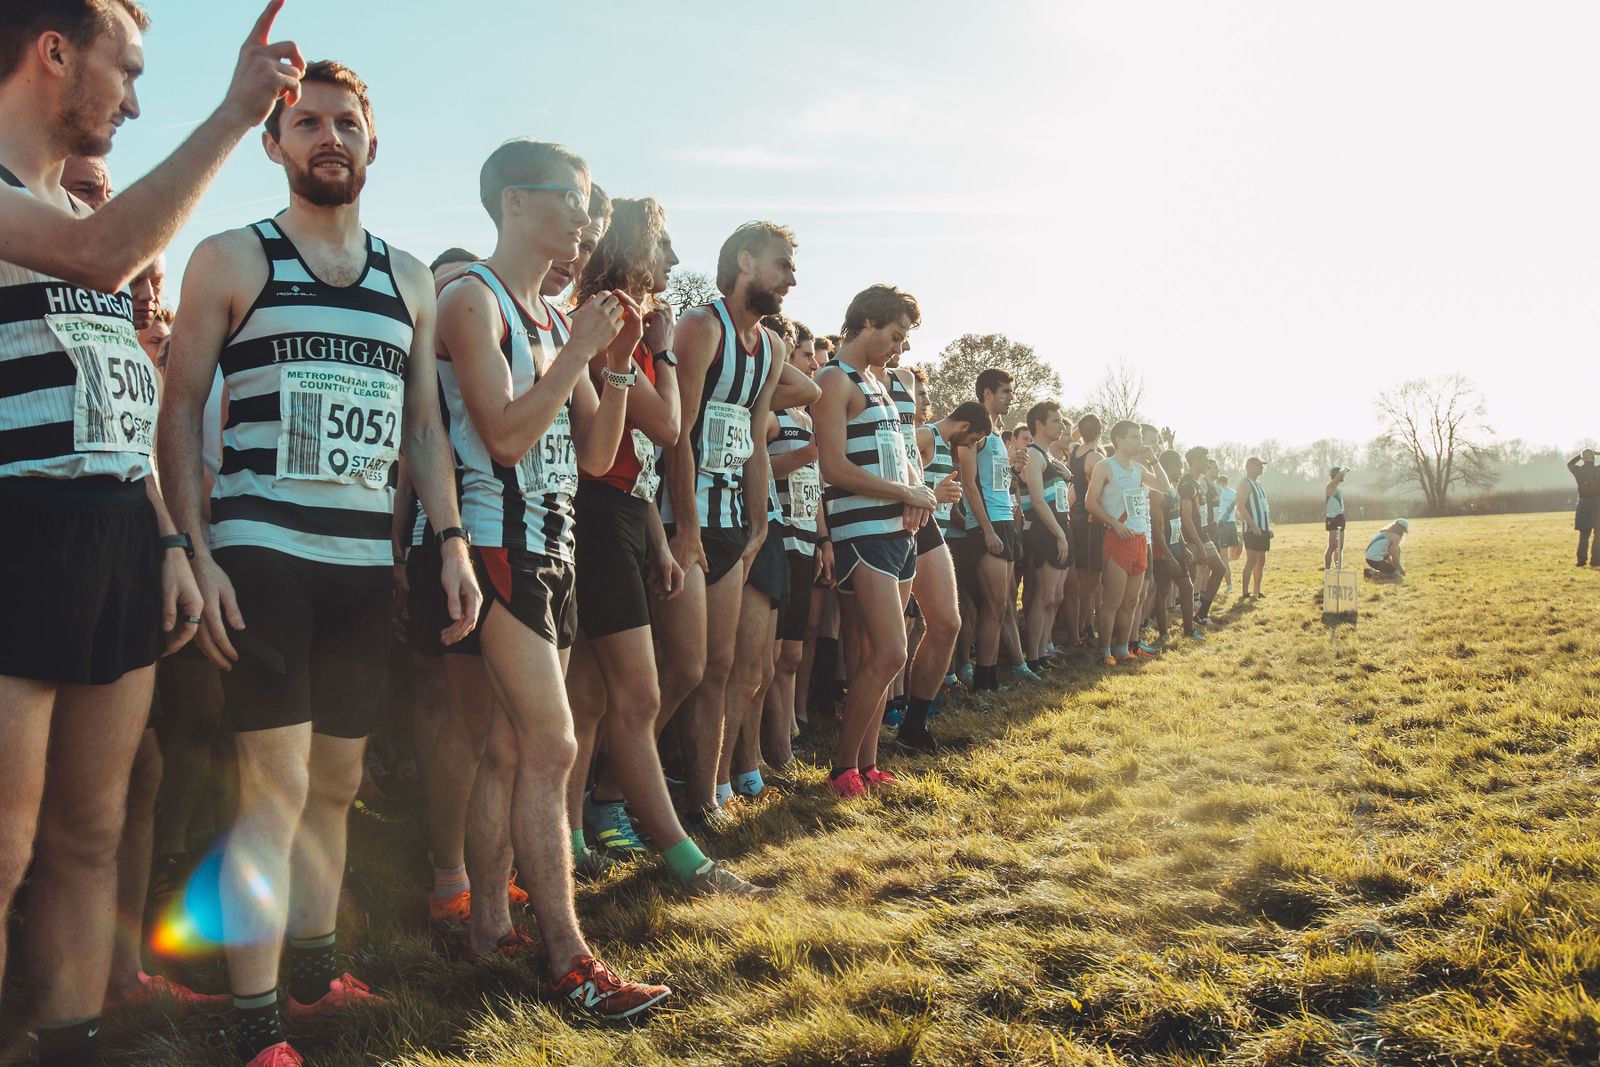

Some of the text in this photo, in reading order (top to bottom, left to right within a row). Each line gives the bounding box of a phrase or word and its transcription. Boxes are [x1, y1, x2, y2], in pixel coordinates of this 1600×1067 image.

[271, 336, 404, 375] HIGHGATE
[108, 357, 156, 406] 5018
[287, 371, 399, 392] METROPOLITAN CROSS
[300, 380, 392, 400] COUNTRY LEAGUE
[327, 403, 397, 449] 5052
[351, 455, 388, 470] START
[349, 469, 383, 482] FITNESS
